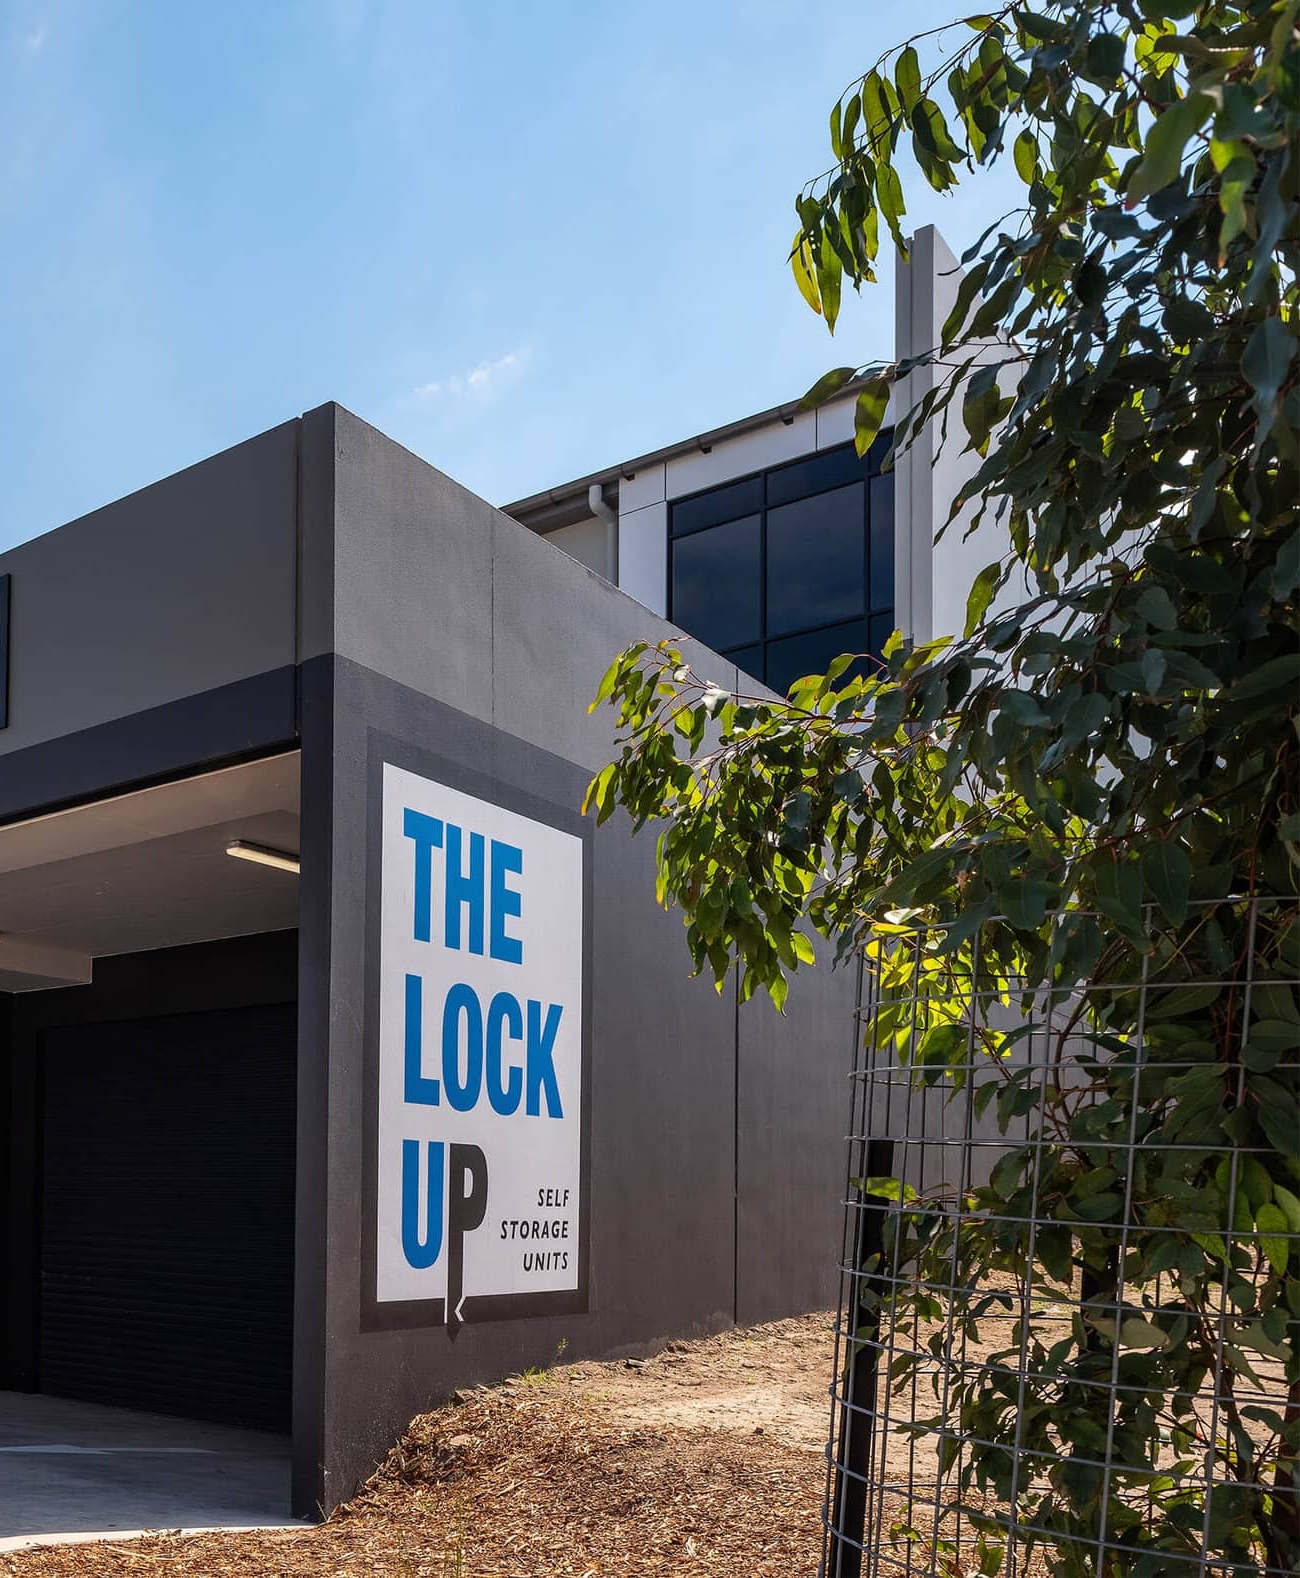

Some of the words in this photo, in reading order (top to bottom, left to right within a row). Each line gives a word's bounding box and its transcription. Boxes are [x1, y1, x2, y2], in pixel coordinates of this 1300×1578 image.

[403, 807, 523, 965] THE
[403, 973, 564, 1119] LOCK
[402, 1138, 488, 1333] UP
[500, 1220, 569, 1240] STORAGE
[537, 1188, 570, 1207] SELF
[523, 1252, 569, 1272] UNITS
